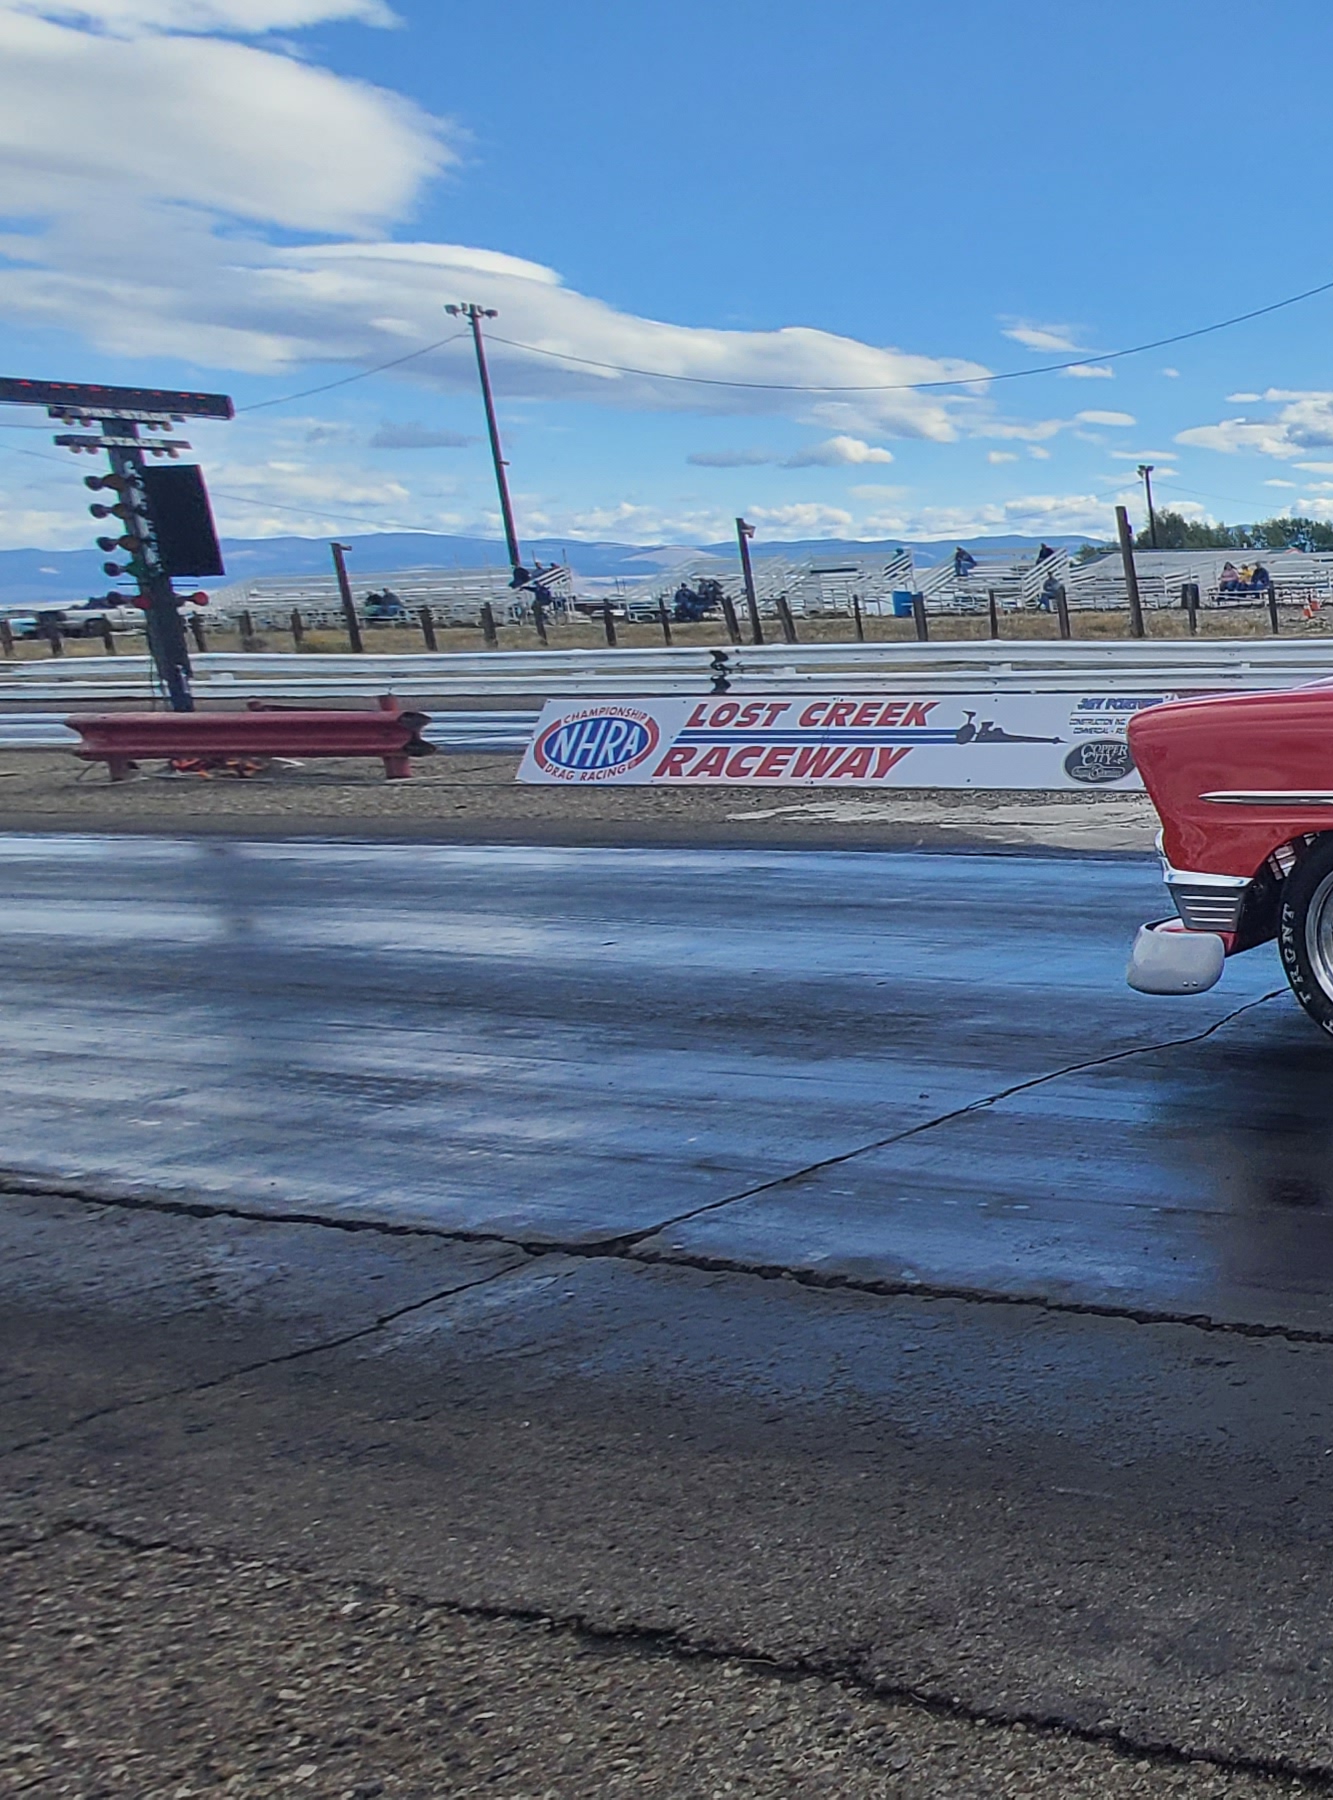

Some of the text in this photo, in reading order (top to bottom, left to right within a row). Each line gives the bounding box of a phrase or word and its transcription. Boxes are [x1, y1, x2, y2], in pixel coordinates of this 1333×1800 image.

[99, 436, 163, 448] STAGE
[563, 706, 648, 724] CHAMPIONSHIP
[685, 701, 940, 728] LOST CREEK
[551, 719, 641, 768] NHRA
[1081, 743, 1128, 758] COPPER
[652, 746, 913, 779] RACEWAY
[1082, 752, 1113, 767] CITY
[544, 763, 627, 781] DRAG RACING
